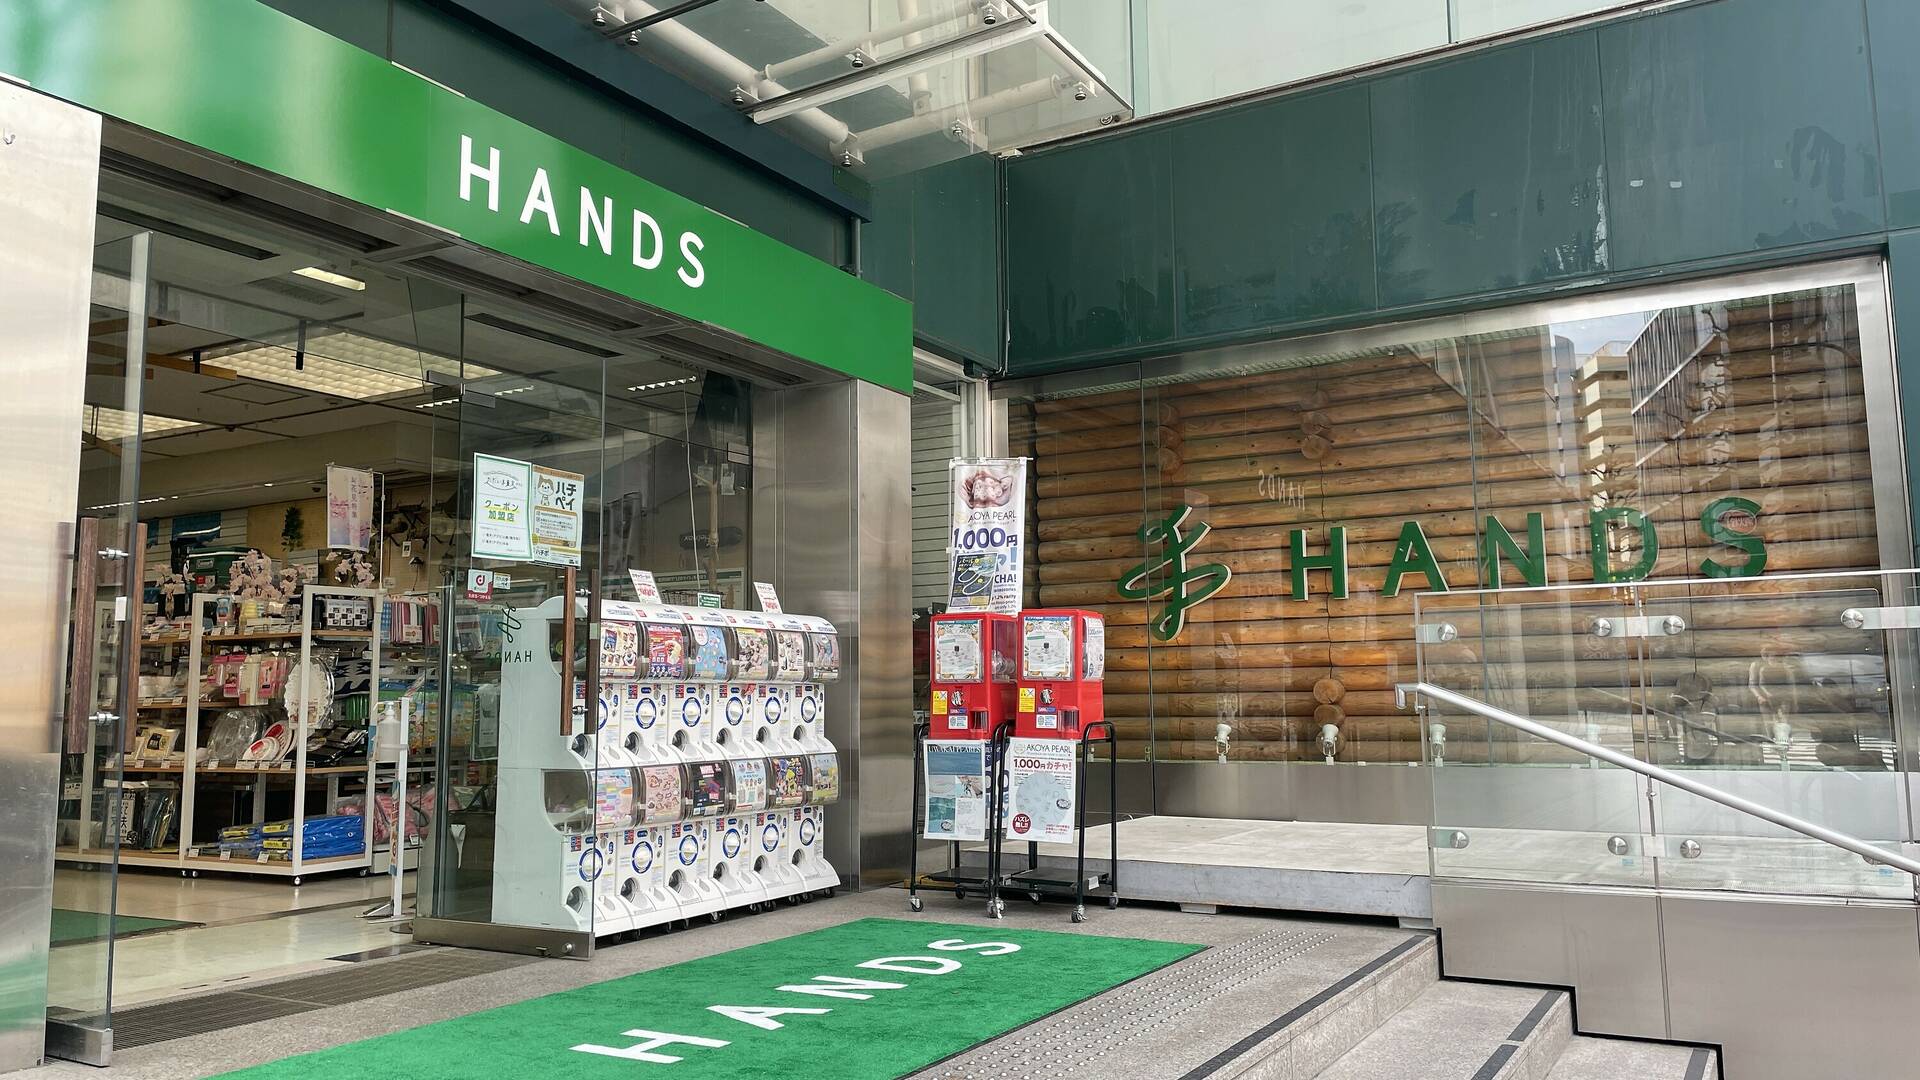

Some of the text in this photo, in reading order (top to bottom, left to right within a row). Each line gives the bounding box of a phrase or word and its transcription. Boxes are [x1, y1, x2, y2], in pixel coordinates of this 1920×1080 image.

[459, 134, 705, 288] HANDS
[555, 481, 577, 497] ハチ
[484, 499, 519, 512] クーポン
[555, 497, 576, 511] ペイ
[488, 510, 515, 522] 加盟店
[992, 510, 1017, 520] PEARL
[953, 527, 1018, 549] 1,000円
[1290, 496, 1768, 600] HANDS
[1026, 743, 1073, 754] AKOYA PEARL
[568, 938, 1022, 1064] HANDS
